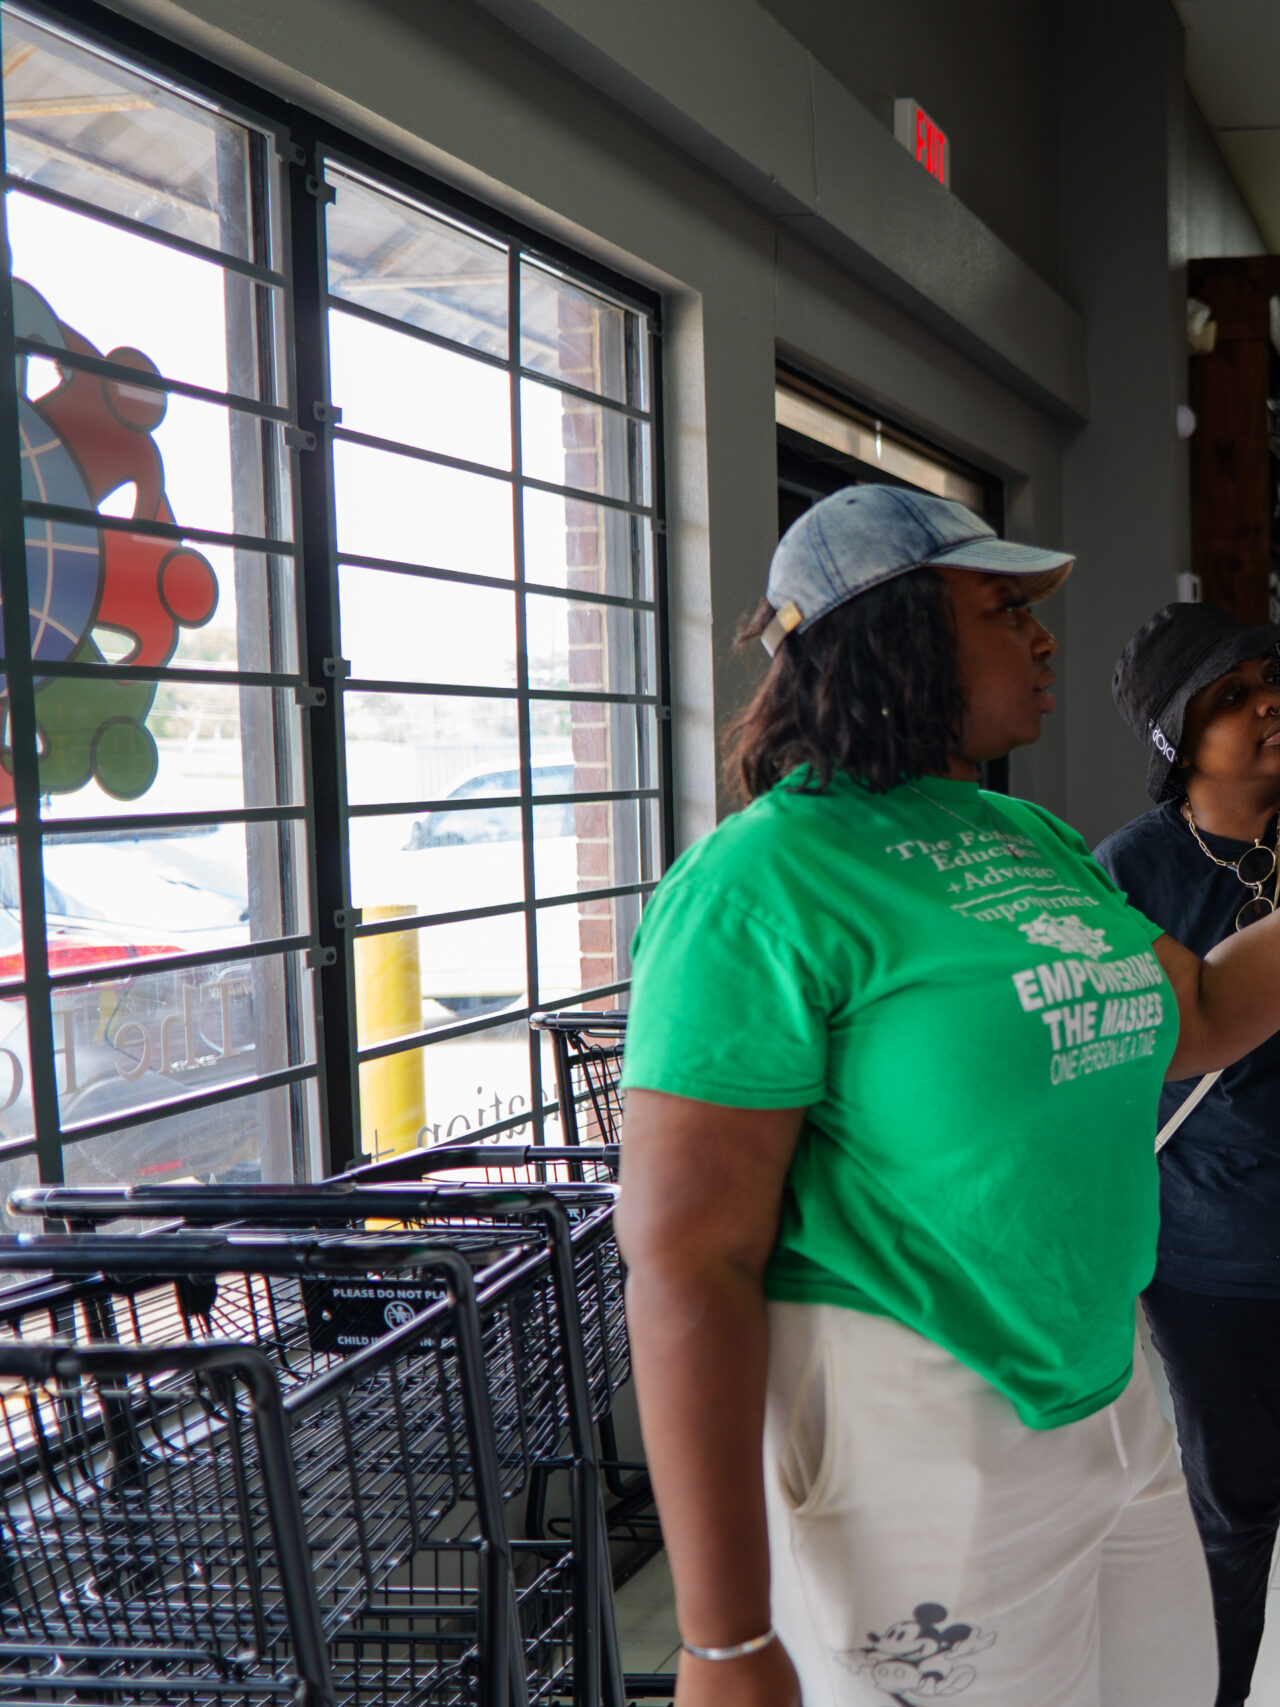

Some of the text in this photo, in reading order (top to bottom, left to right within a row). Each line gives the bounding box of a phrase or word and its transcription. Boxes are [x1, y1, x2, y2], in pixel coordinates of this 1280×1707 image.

[916, 107, 946, 184] EXIT
[885, 839, 952, 861] The
[1011, 951, 1163, 1013] EMPOWERING
[1041, 992, 1164, 1051] THE MASSES
[1050, 1049, 1079, 1086] ONE
[333, 1288, 374, 1298] PLEASE
[377, 1289, 394, 1299] DO
[397, 1290, 421, 1299] NOT
[337, 1336, 369, 1345] CHILD
